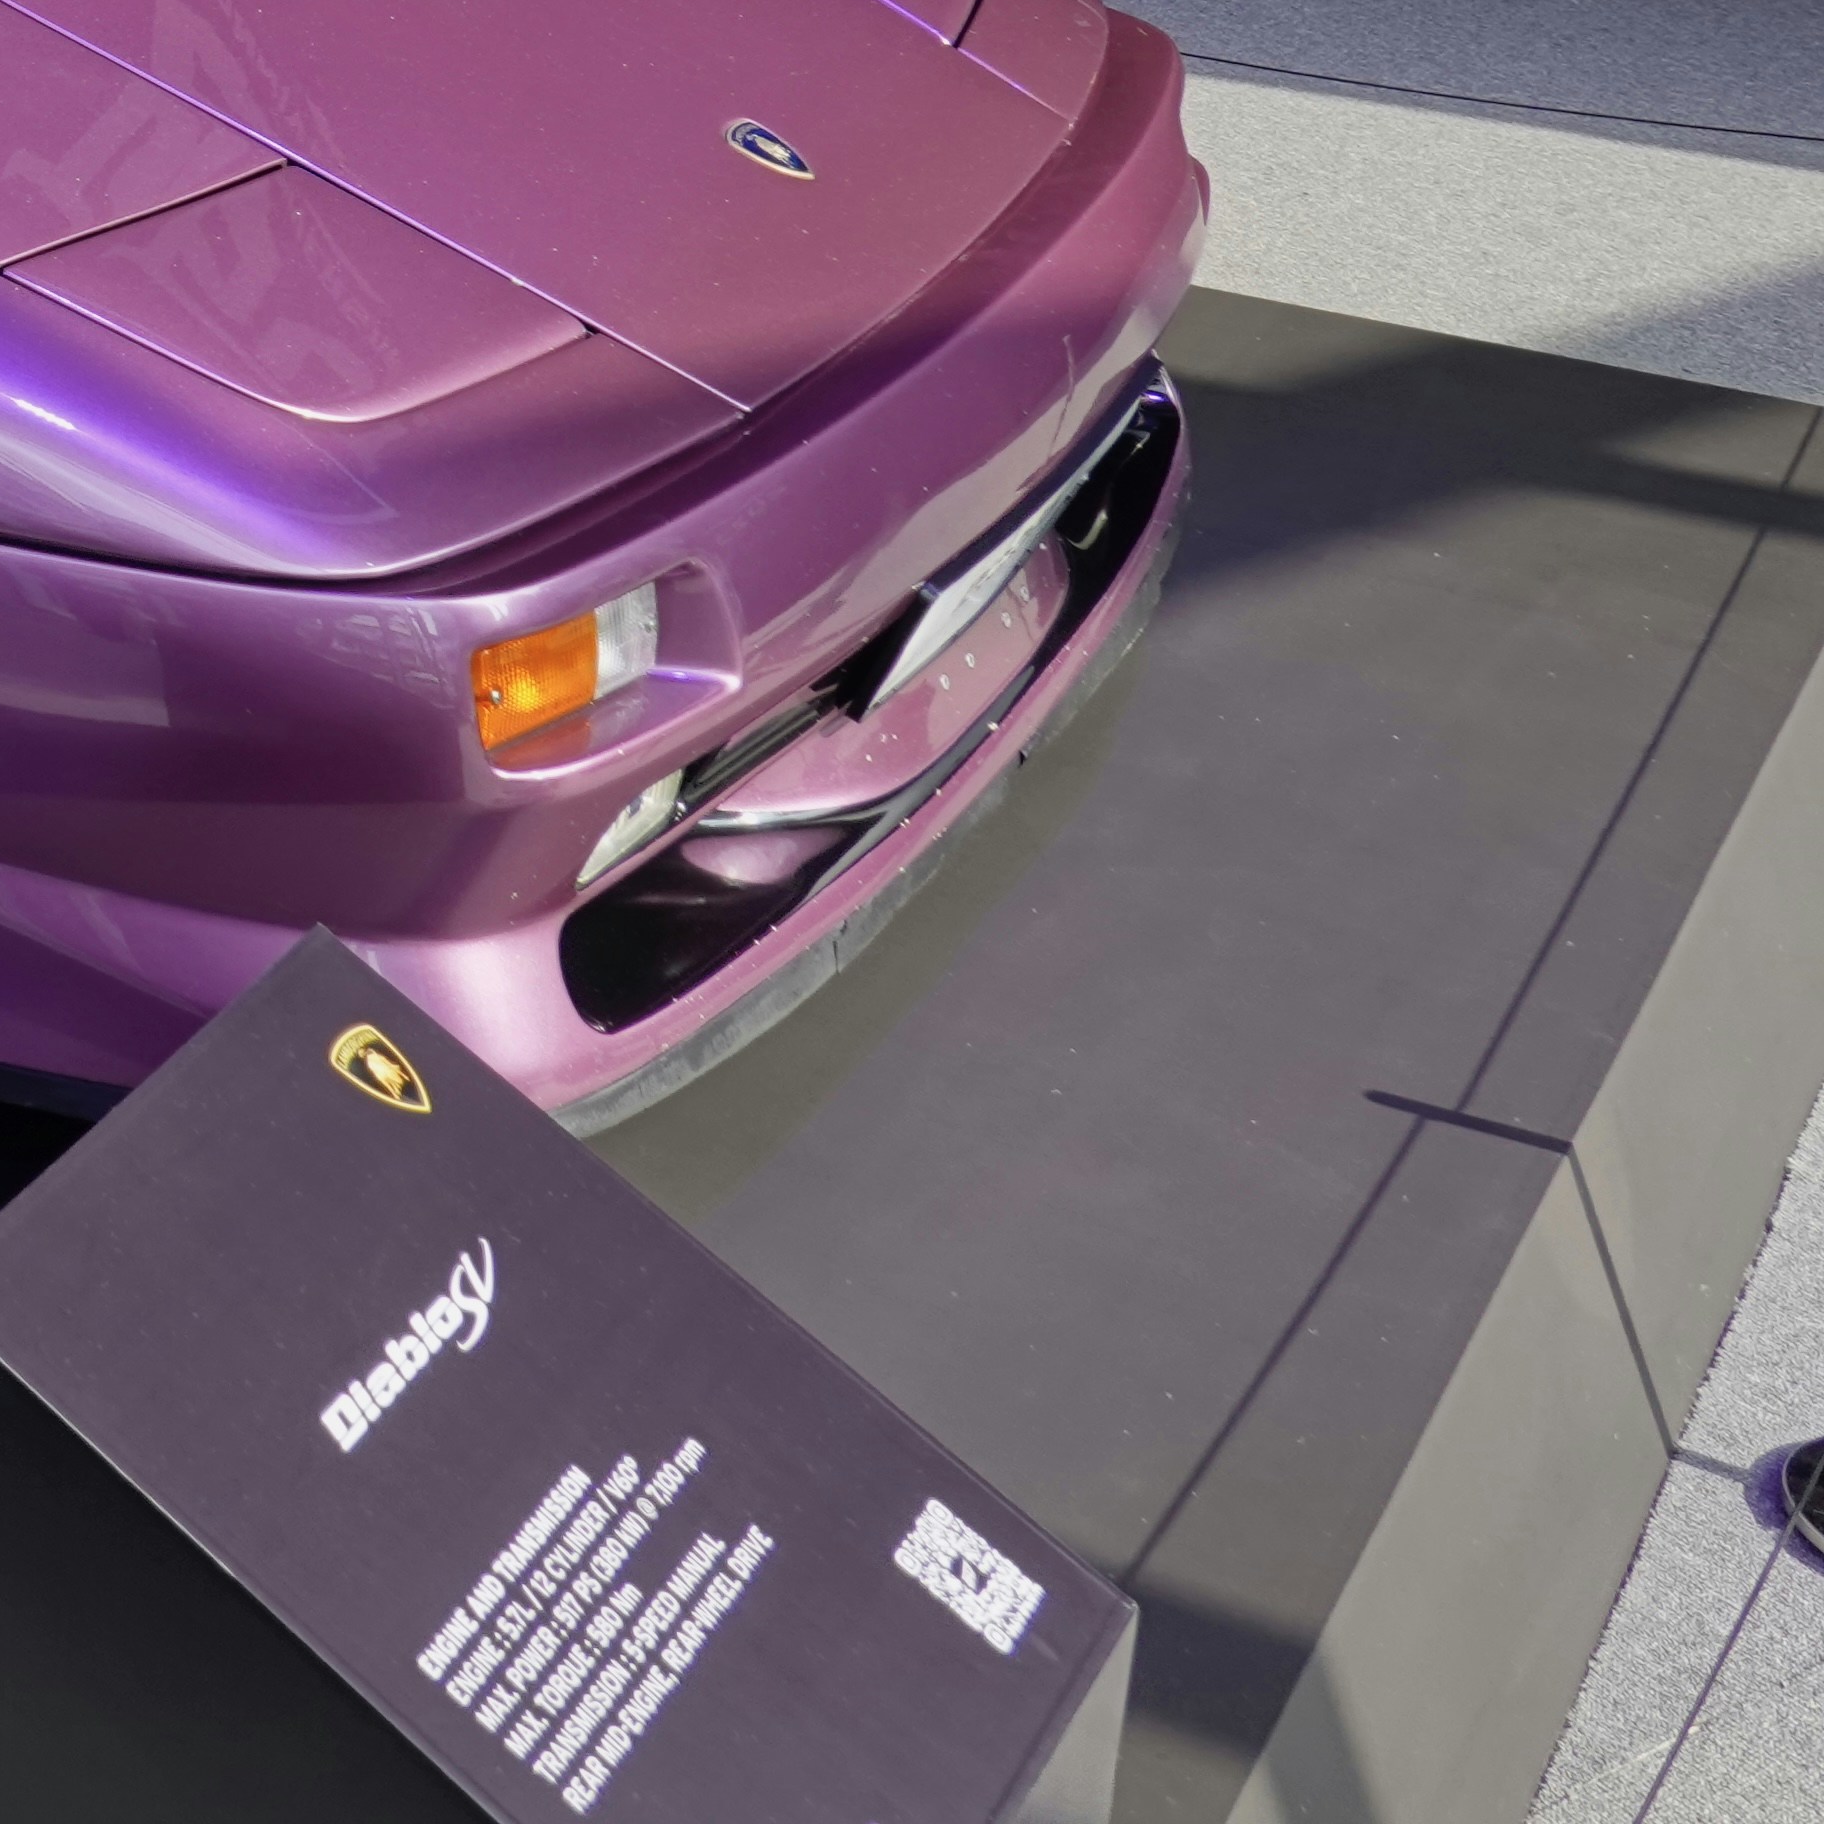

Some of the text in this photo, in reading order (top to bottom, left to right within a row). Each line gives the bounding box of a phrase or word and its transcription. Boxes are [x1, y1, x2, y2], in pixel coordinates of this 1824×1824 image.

[543, 1500, 610, 1581] CYLINDER
[596, 1488, 618, 1514] /
[416, 1464, 592, 1681] ENGINE AND TRANSMISSION
[505, 1626, 562, 1692] POWER
[552, 1592, 585, 1630] 517
[572, 1571, 603, 1604] PS
[589, 1537, 628, 1583] (380
[614, 1511, 650, 1548] kW)
[636, 1497, 658, 1520] @
[674, 1437, 706, 1473] rpm
[522, 1584, 543, 1611] /
[529, 1569, 557, 1598] 12
[496, 1601, 536, 1641] 5.7L
[532, 1659, 632, 1784] TRANSMISSION
[621, 1590, 681, 1663] 5-SPEED
[666, 1532, 726, 1601] MANUAL
[533, 1643, 596, 1716] TORQUE
[586, 1606, 624, 1648] 580
[609, 1583, 644, 1616] Nm
[446, 1636, 506, 1707] ENGINE
[562, 1524, 774, 1814] REAR MID-ENGINE, REAR-WHEEL DRIVE
